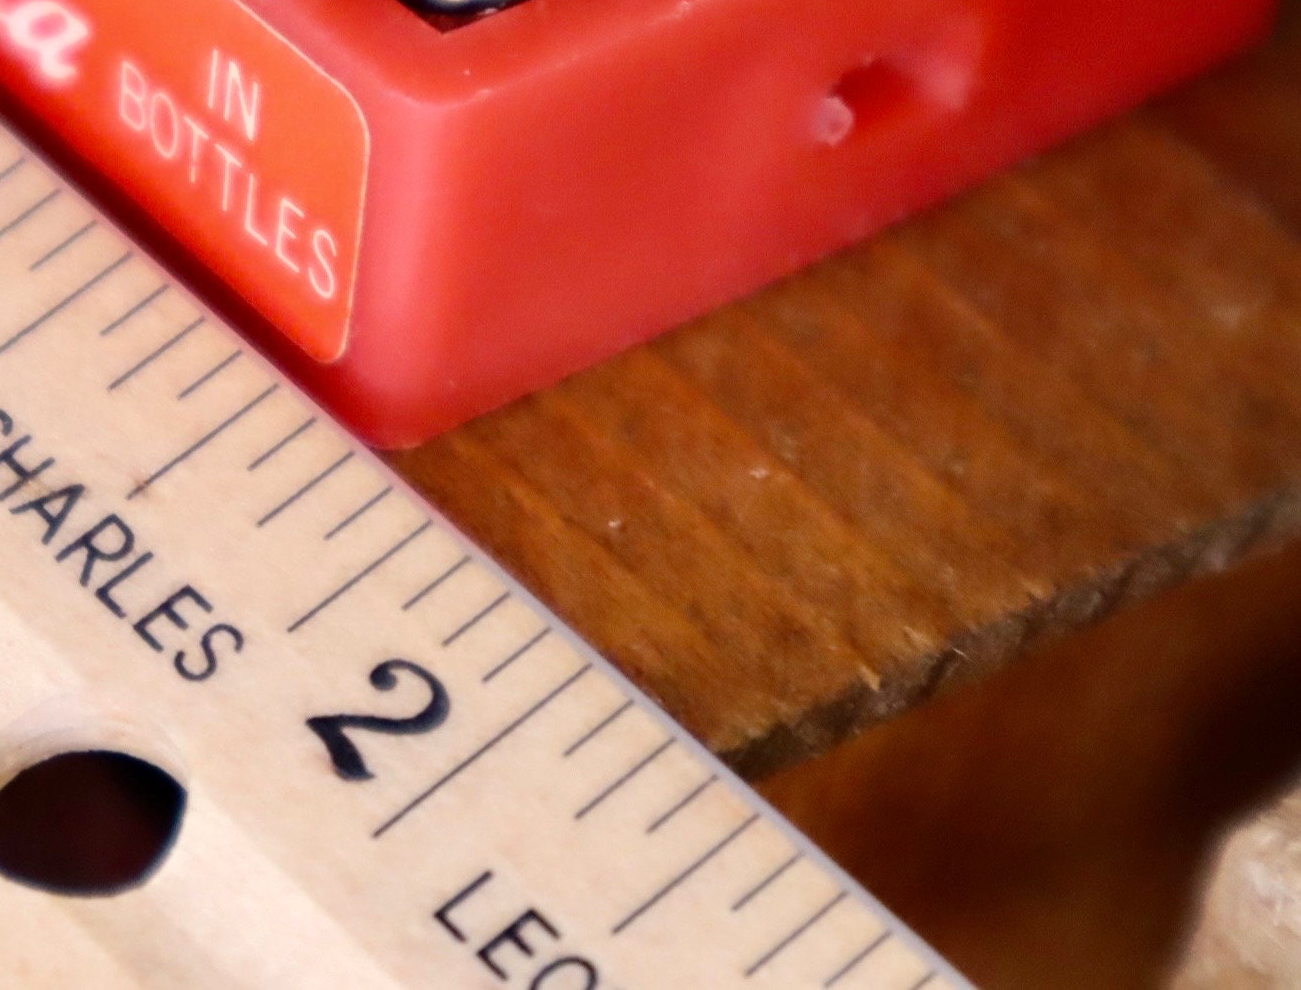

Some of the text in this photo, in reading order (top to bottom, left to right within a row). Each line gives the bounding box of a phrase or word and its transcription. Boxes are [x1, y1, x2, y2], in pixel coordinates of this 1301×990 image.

[206, 47, 260, 142] IN
[118, 60, 339, 300] BOTTLES
[306, 659, 452, 782] 2
